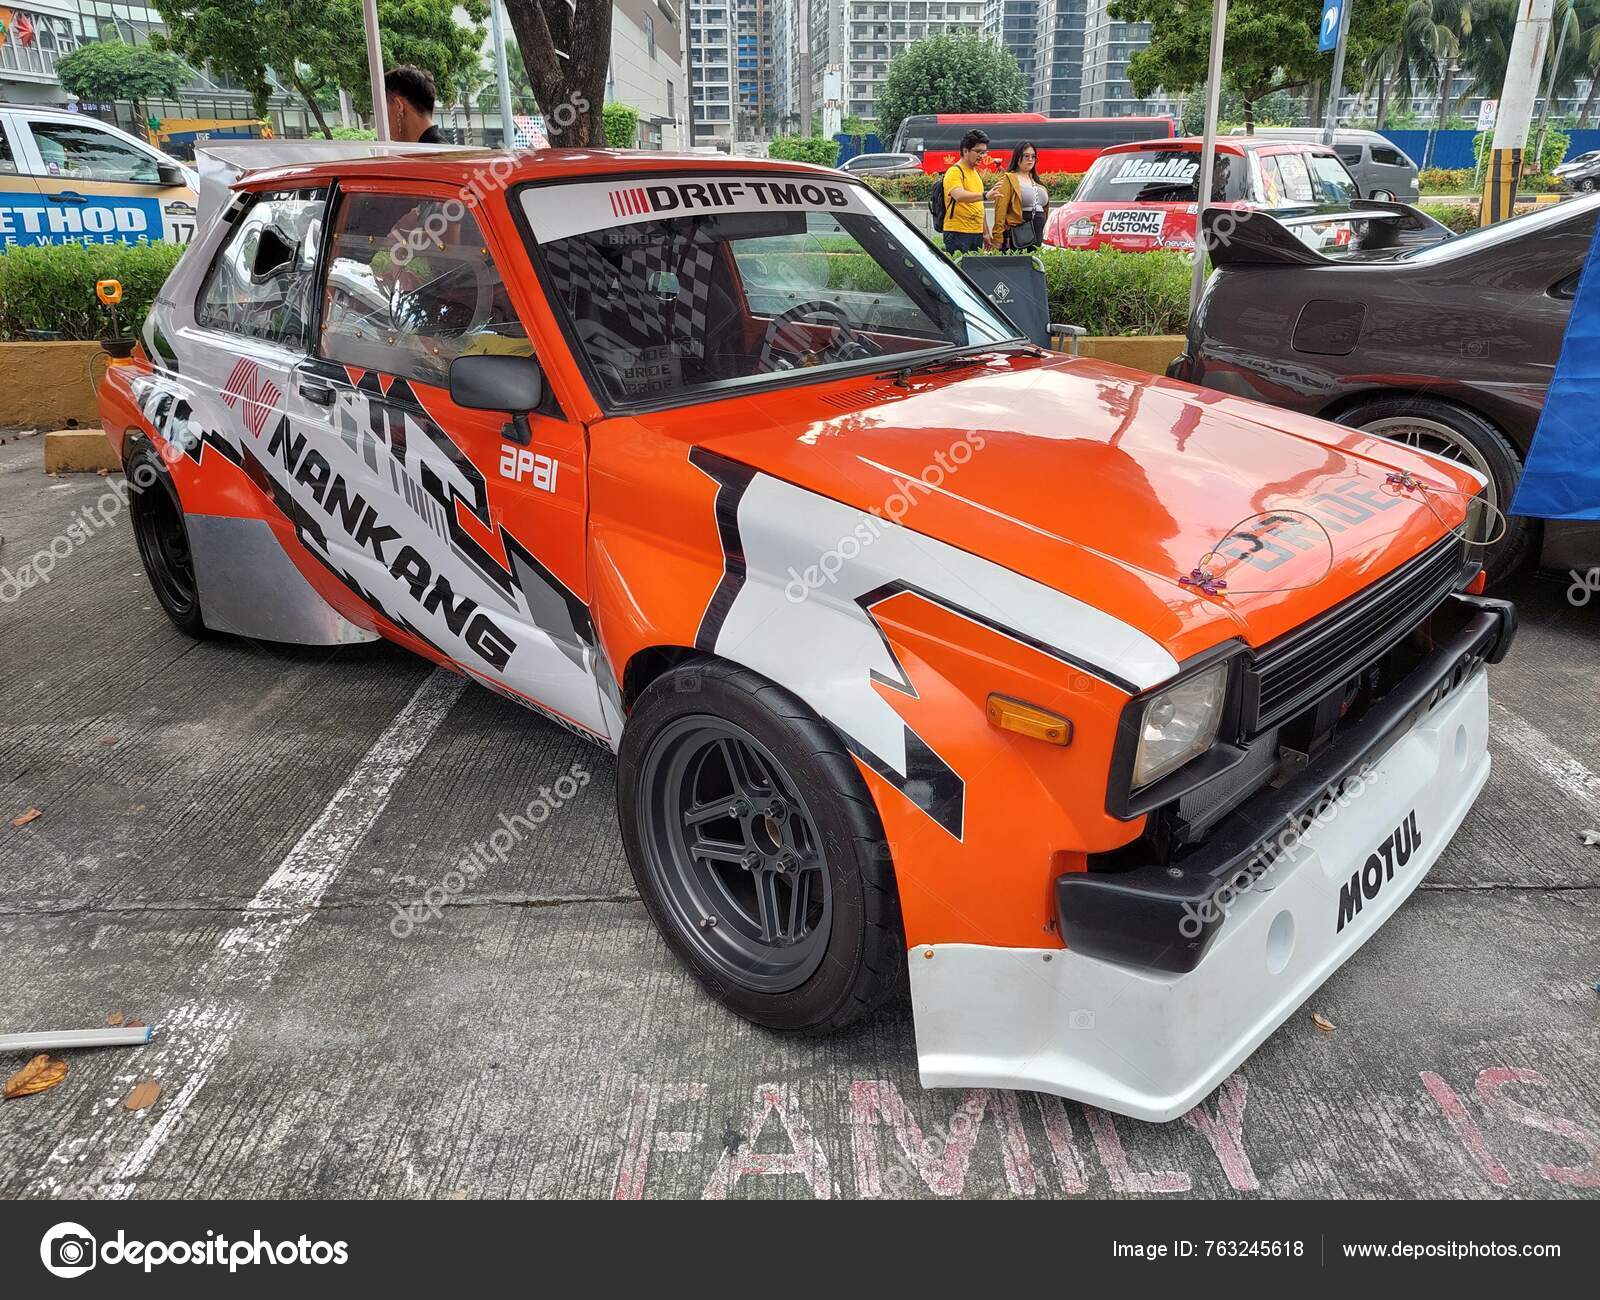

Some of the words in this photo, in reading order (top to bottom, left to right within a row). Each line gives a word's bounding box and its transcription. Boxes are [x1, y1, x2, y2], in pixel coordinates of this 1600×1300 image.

[1117, 159, 1199, 177] ManMa
[646, 183, 848, 212] DRIFTMOB
[1107, 212, 1159, 222] IMPRINT
[172, 223, 195, 244] 17
[1101, 222, 1160, 234] CUSTOMS
[36, 234, 149, 246] WHEELS
[267, 414, 518, 673] NANKANG
[1336, 809, 1421, 934] MOTUL
[1419, 1067, 1600, 1188] IS
